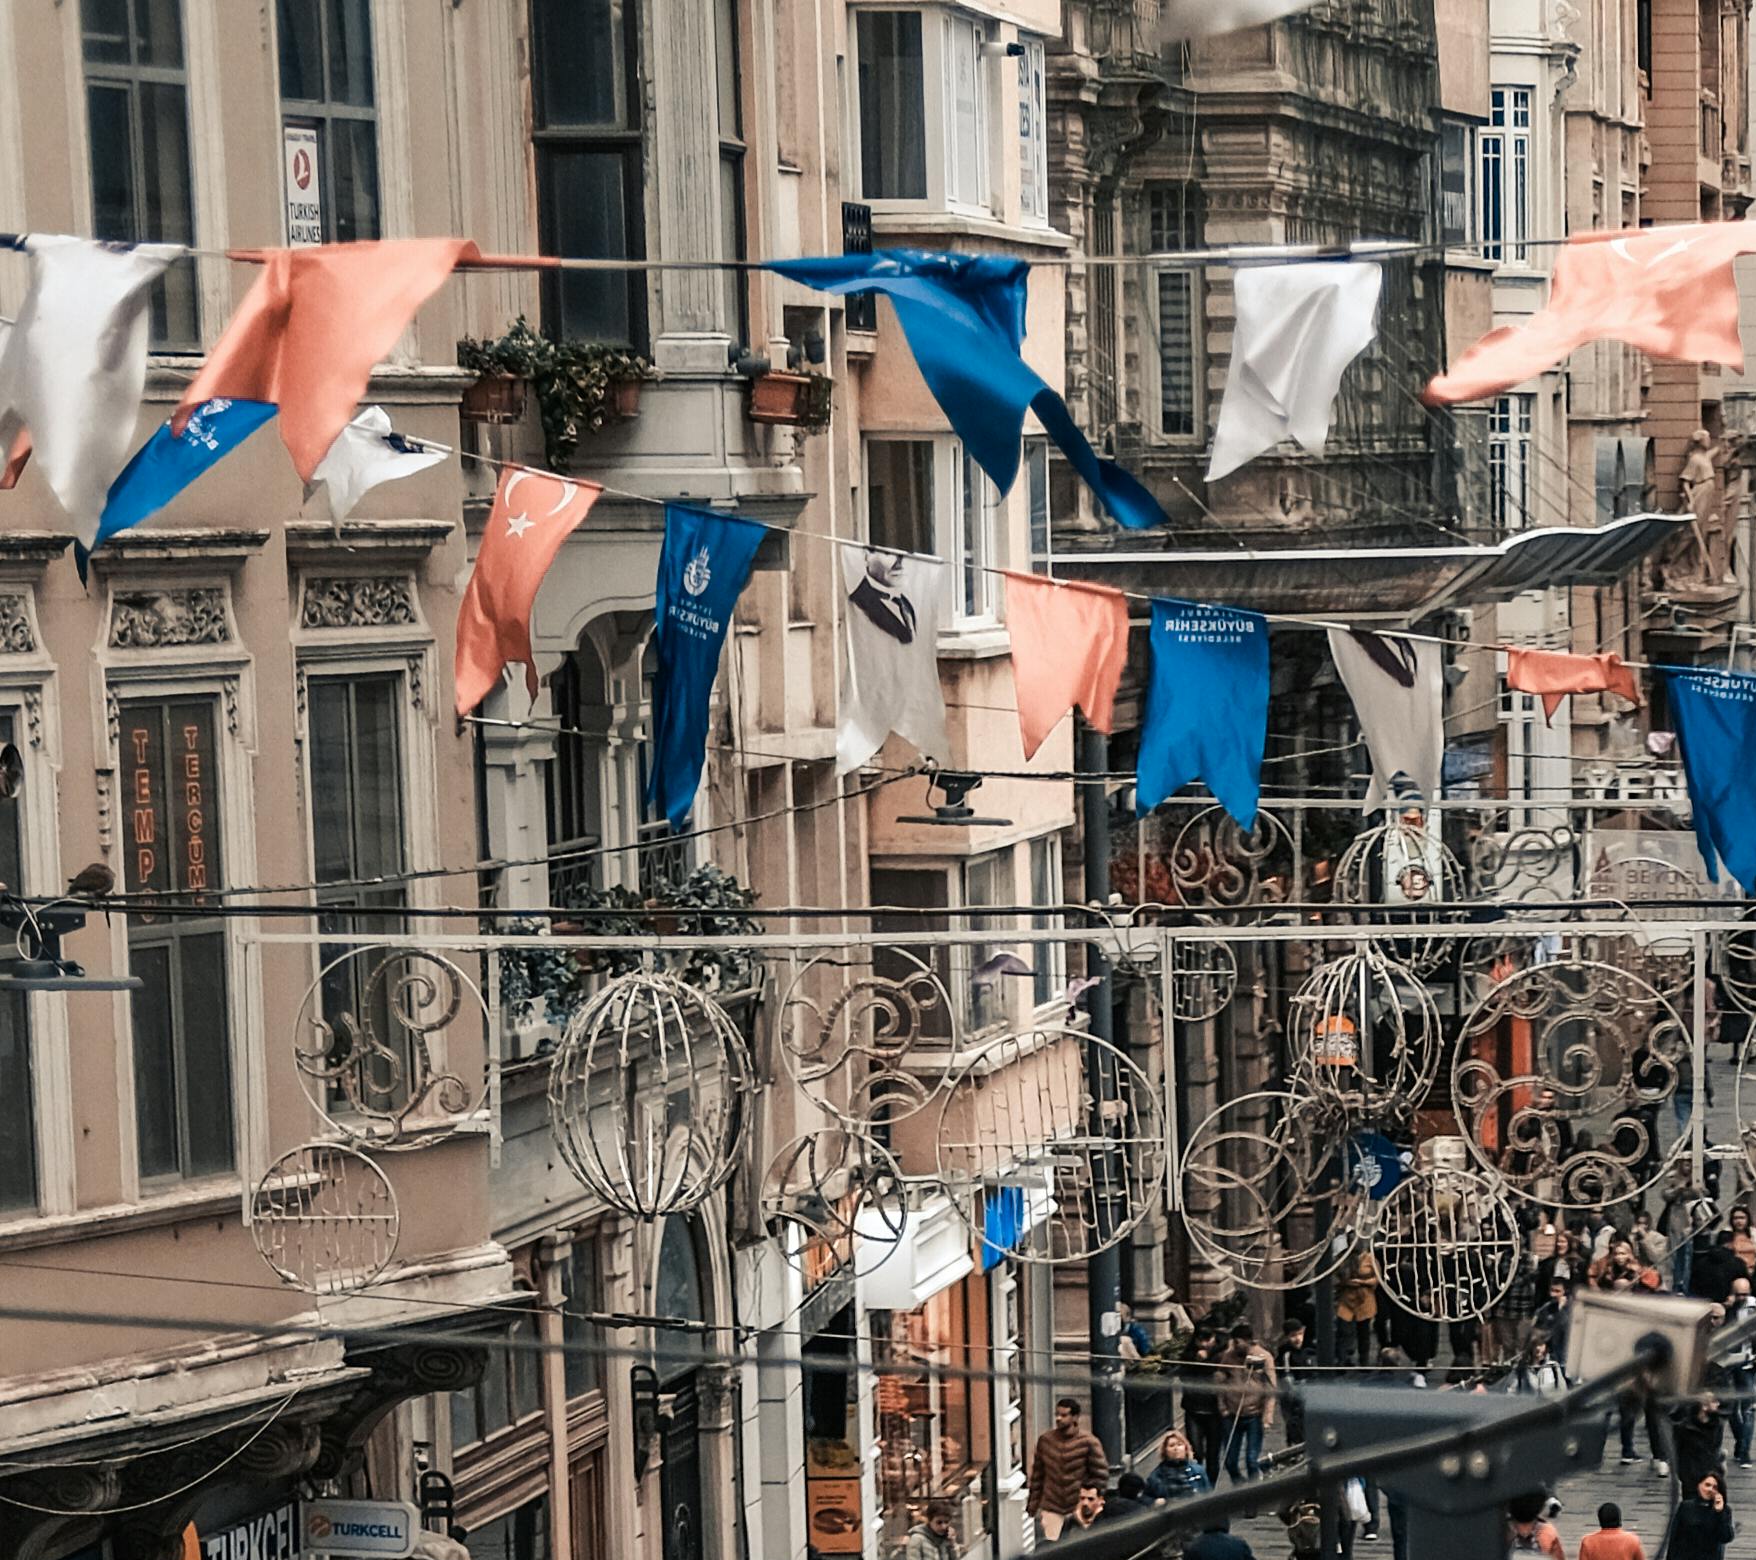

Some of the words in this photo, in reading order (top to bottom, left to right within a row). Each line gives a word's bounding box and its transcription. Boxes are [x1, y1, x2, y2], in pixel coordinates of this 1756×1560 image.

[290, 202, 319, 220] TURKISH
[291, 224, 321, 243] AIRLINES
[333, 1521, 403, 1539] TURKCELL
